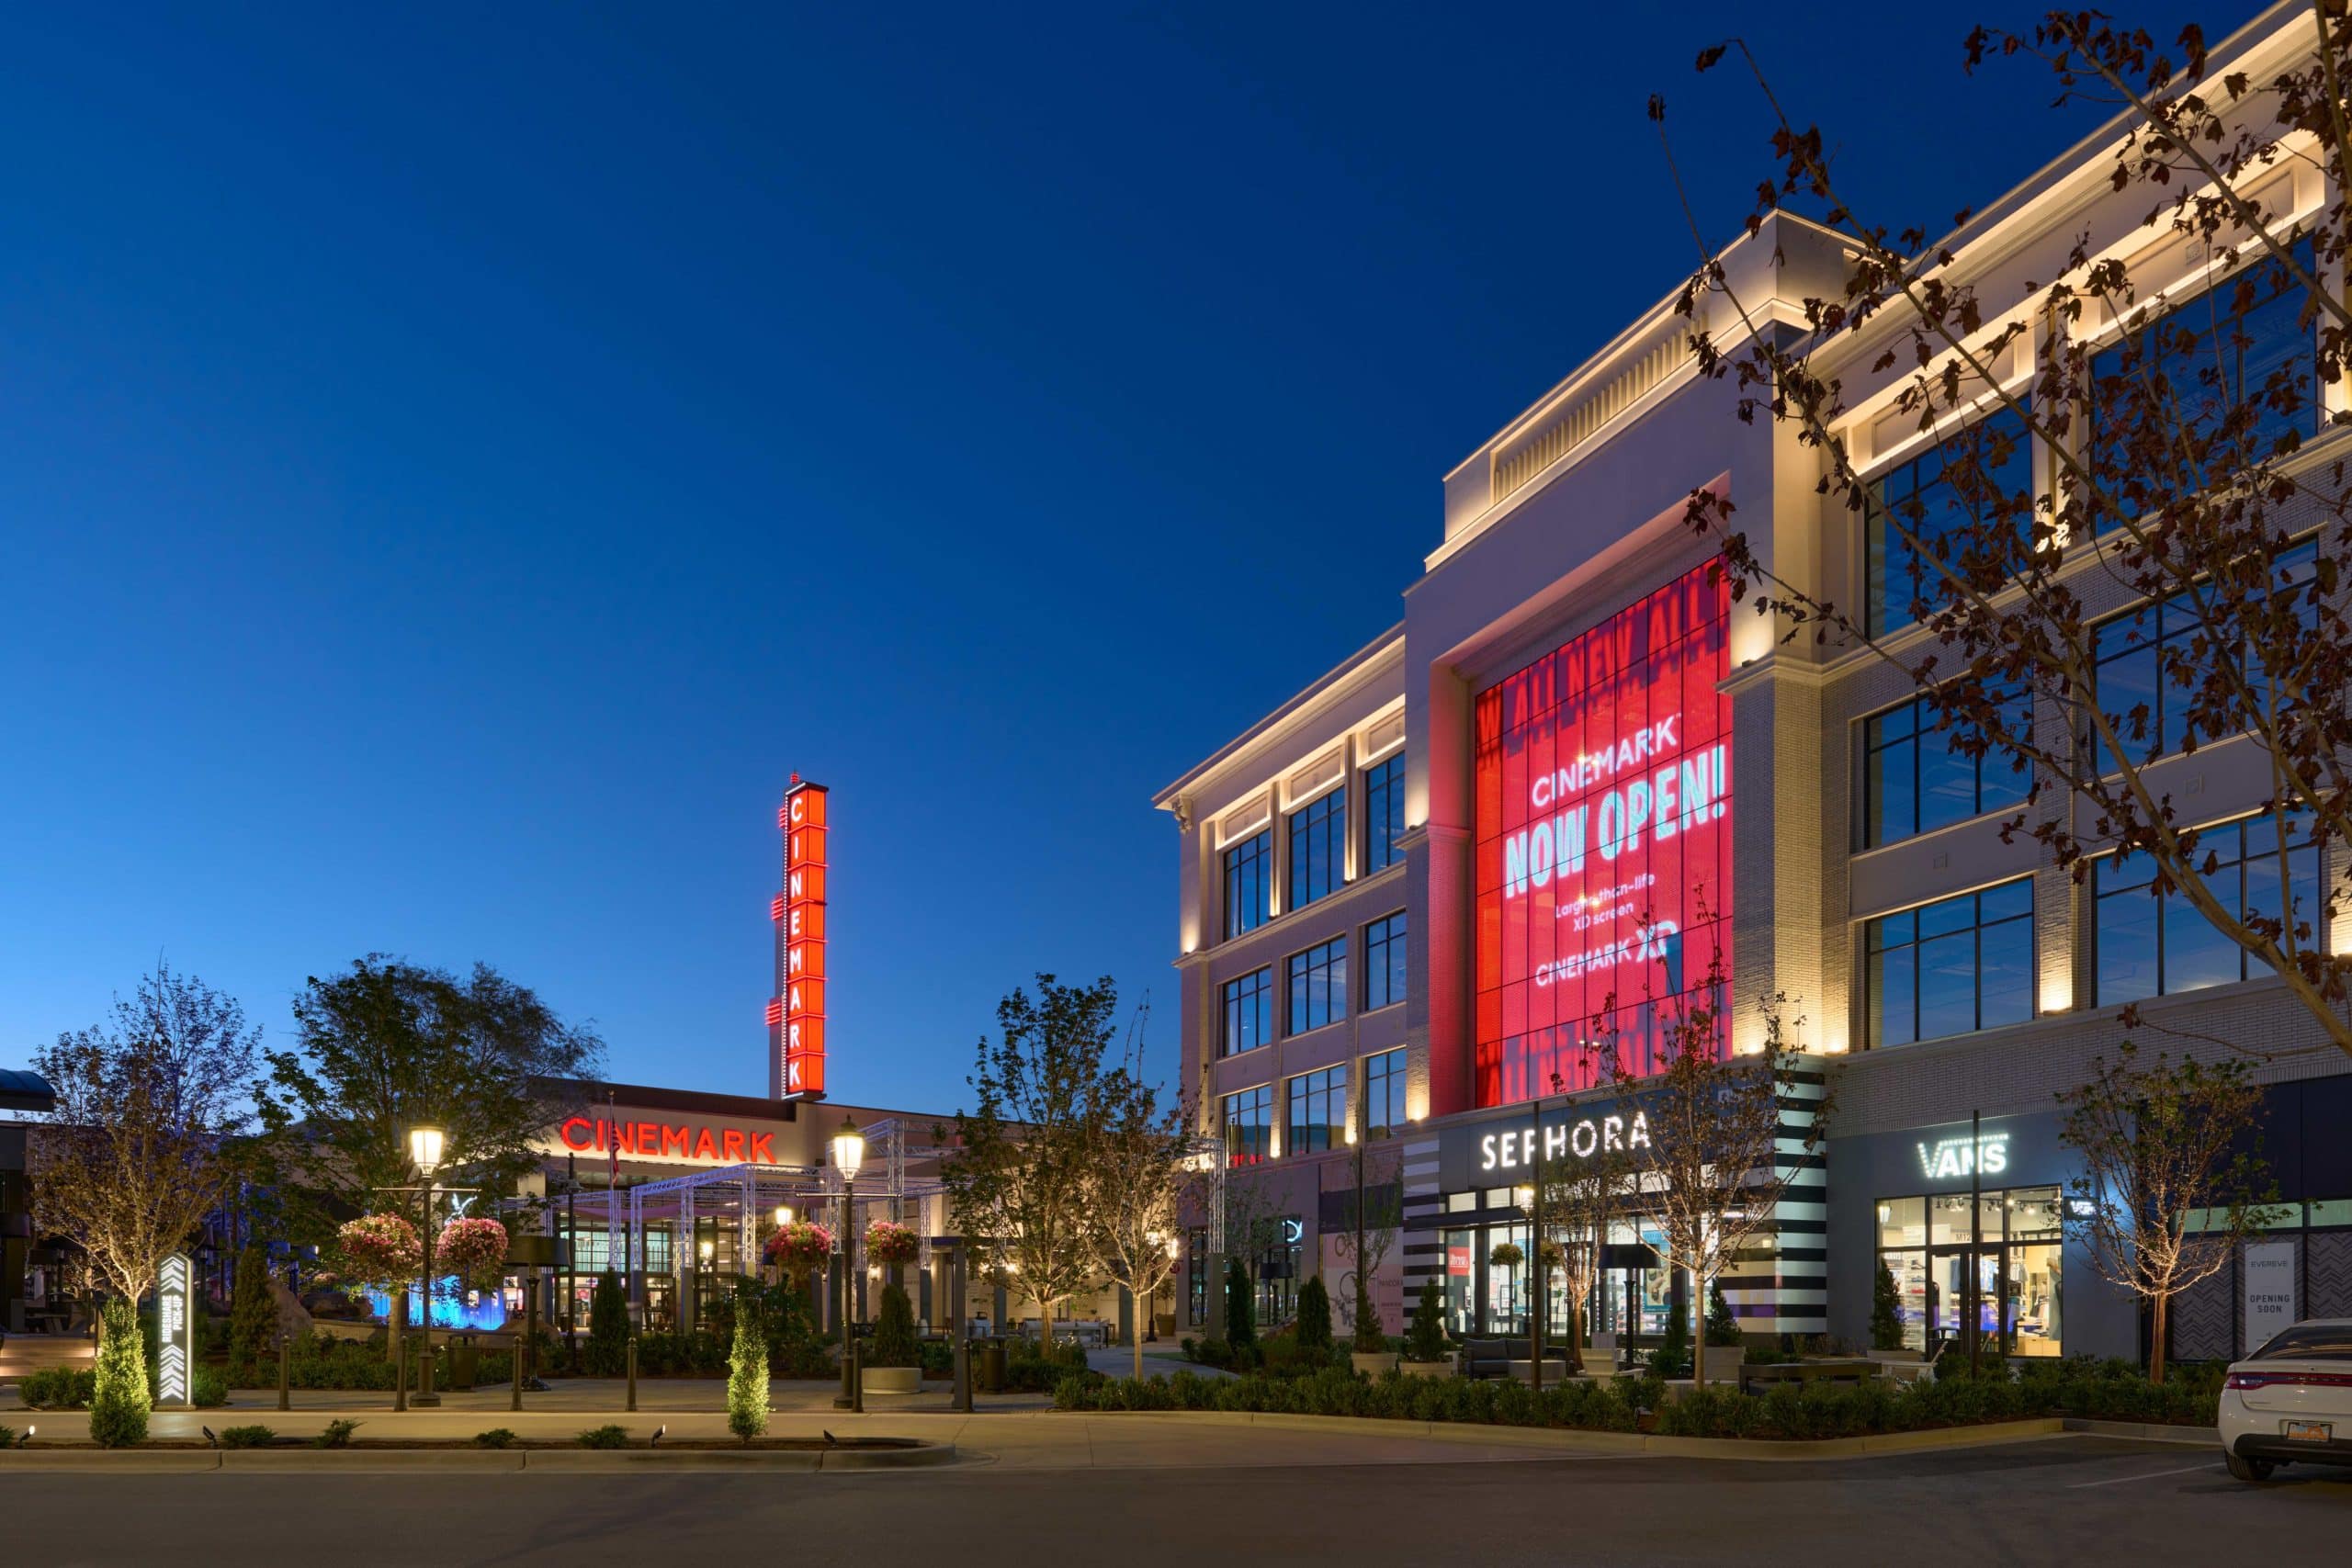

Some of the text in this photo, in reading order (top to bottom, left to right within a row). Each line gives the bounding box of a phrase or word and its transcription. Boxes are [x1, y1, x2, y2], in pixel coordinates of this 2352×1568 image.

[1532, 716, 1678, 807] CINEMARK
[1506, 744, 1726, 899] NOW OPEN!
[1592, 902, 1634, 926] screen
[787, 796, 804, 1087] CINEMARK
[1535, 938, 1633, 987] CINEMARK
[560, 1116, 777, 1164] CINEMARK
[1917, 1133, 2009, 1178] VANS
[161, 1294, 173, 1343] RIDESHARE
[173, 1294, 184, 1331] PICK-UP
[2249, 1294, 2290, 1303] OPENING
[2256, 1304, 2282, 1314] SOON
